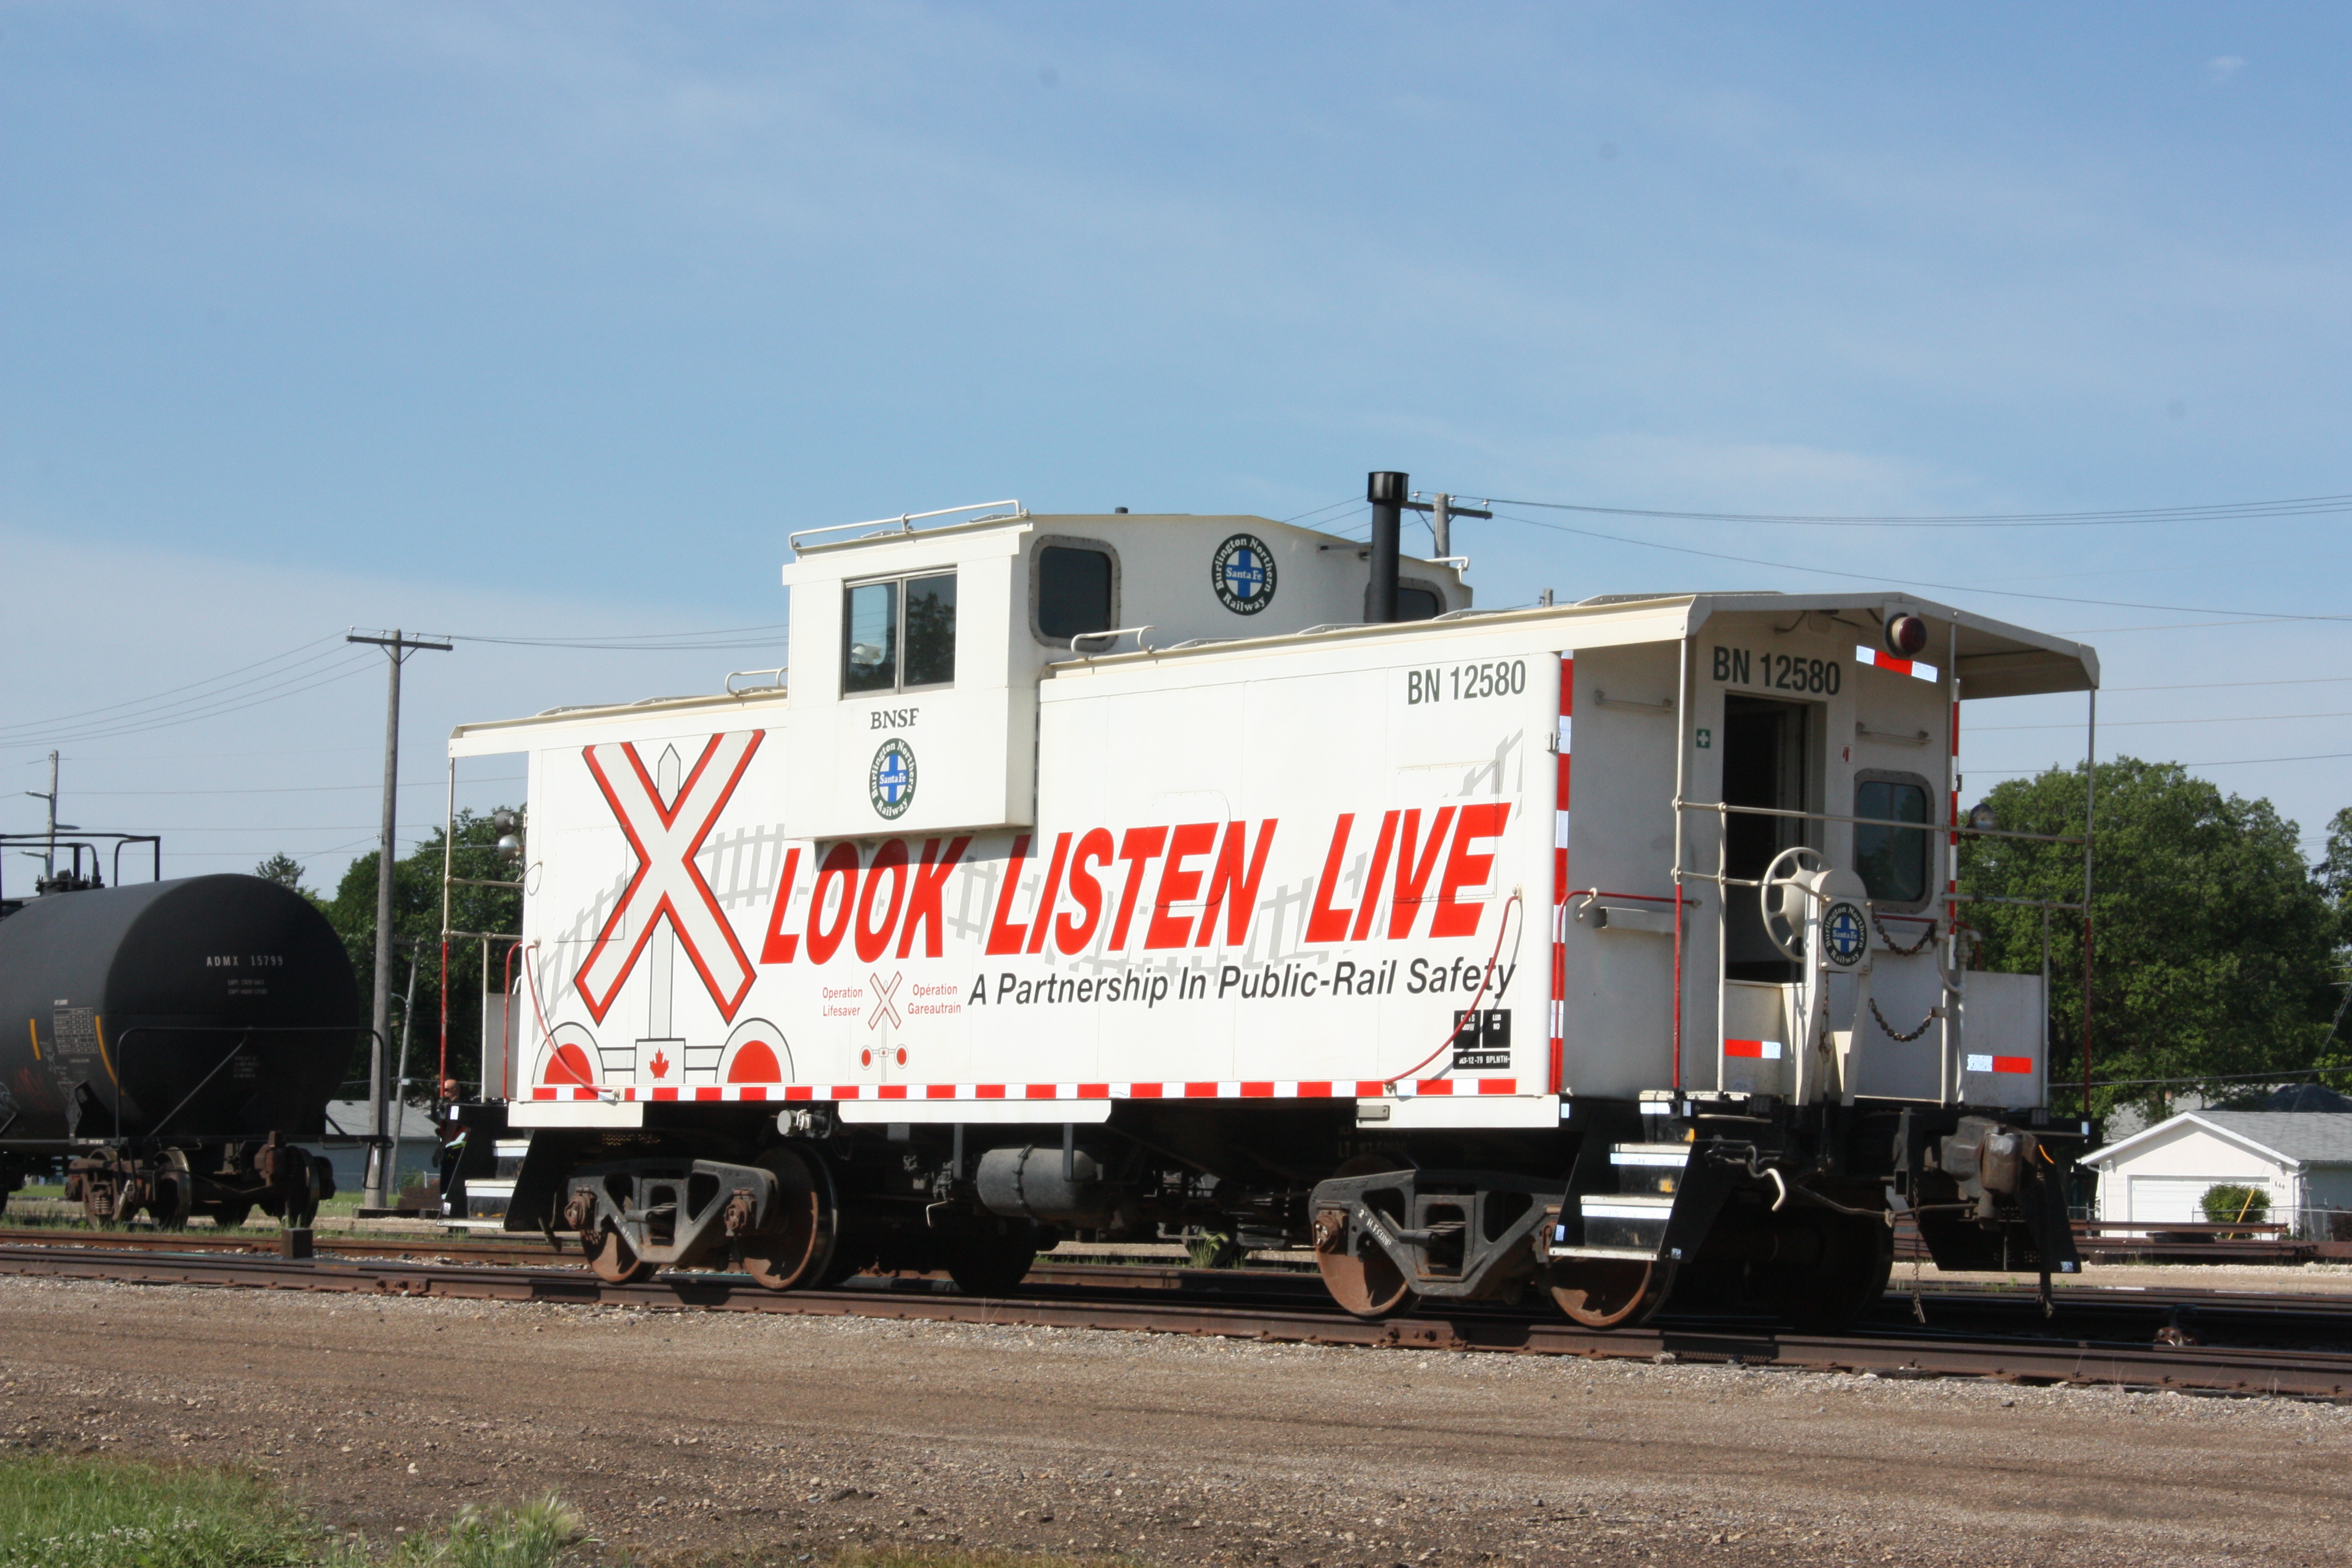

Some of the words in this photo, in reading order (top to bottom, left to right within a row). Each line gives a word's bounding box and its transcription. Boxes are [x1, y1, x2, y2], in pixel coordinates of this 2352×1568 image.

[1215, 538, 1248, 591] Burlington
[1249, 537, 1273, 592] Northern
[1226, 567, 1251, 579] Santa
[1252, 570, 1262, 581] Fe
[1223, 592, 1265, 612] Railway
[1713, 646, 1750, 684] BN
[1760, 653, 1841, 695] 12580
[1408, 668, 1440, 705] BN
[1450, 660, 1526, 700] 12580
[870, 707, 919, 730] BNSF
[871, 742, 896, 799] Burlington
[897, 740, 915, 793] Northern
[879, 774, 899, 785] Santa
[899, 772, 907, 783] Fe
[876, 798, 908, 817] Railway
[760, 836, 973, 965] LOOK
[985, 818, 1278, 956] LISTEN
[1305, 802, 1512, 943] LIVE
[1825, 907, 1847, 948] Burlington
[1848, 906, 1865, 948] Northern
[1832, 929, 1850, 939] Santa
[1850, 931, 1858, 939] Fe
[206, 956, 238, 966] ADMX
[251, 955, 282, 966] 15799
[1831, 949, 1859, 963] Railway
[912, 983, 958, 998] Opération
[968, 974, 987, 1005] A
[997, 969, 1168, 1009] Partnership
[1179, 967, 1206, 999] In
[1218, 960, 1397, 998] Public-Rail
[1407, 957, 1516, 1000] Safety
[823, 987, 863, 1001] Operation
[823, 1005, 861, 1017] Lifesaver
[907, 1002, 961, 1015] Gareautrain
[1460, 1014, 1476, 1022] CS
